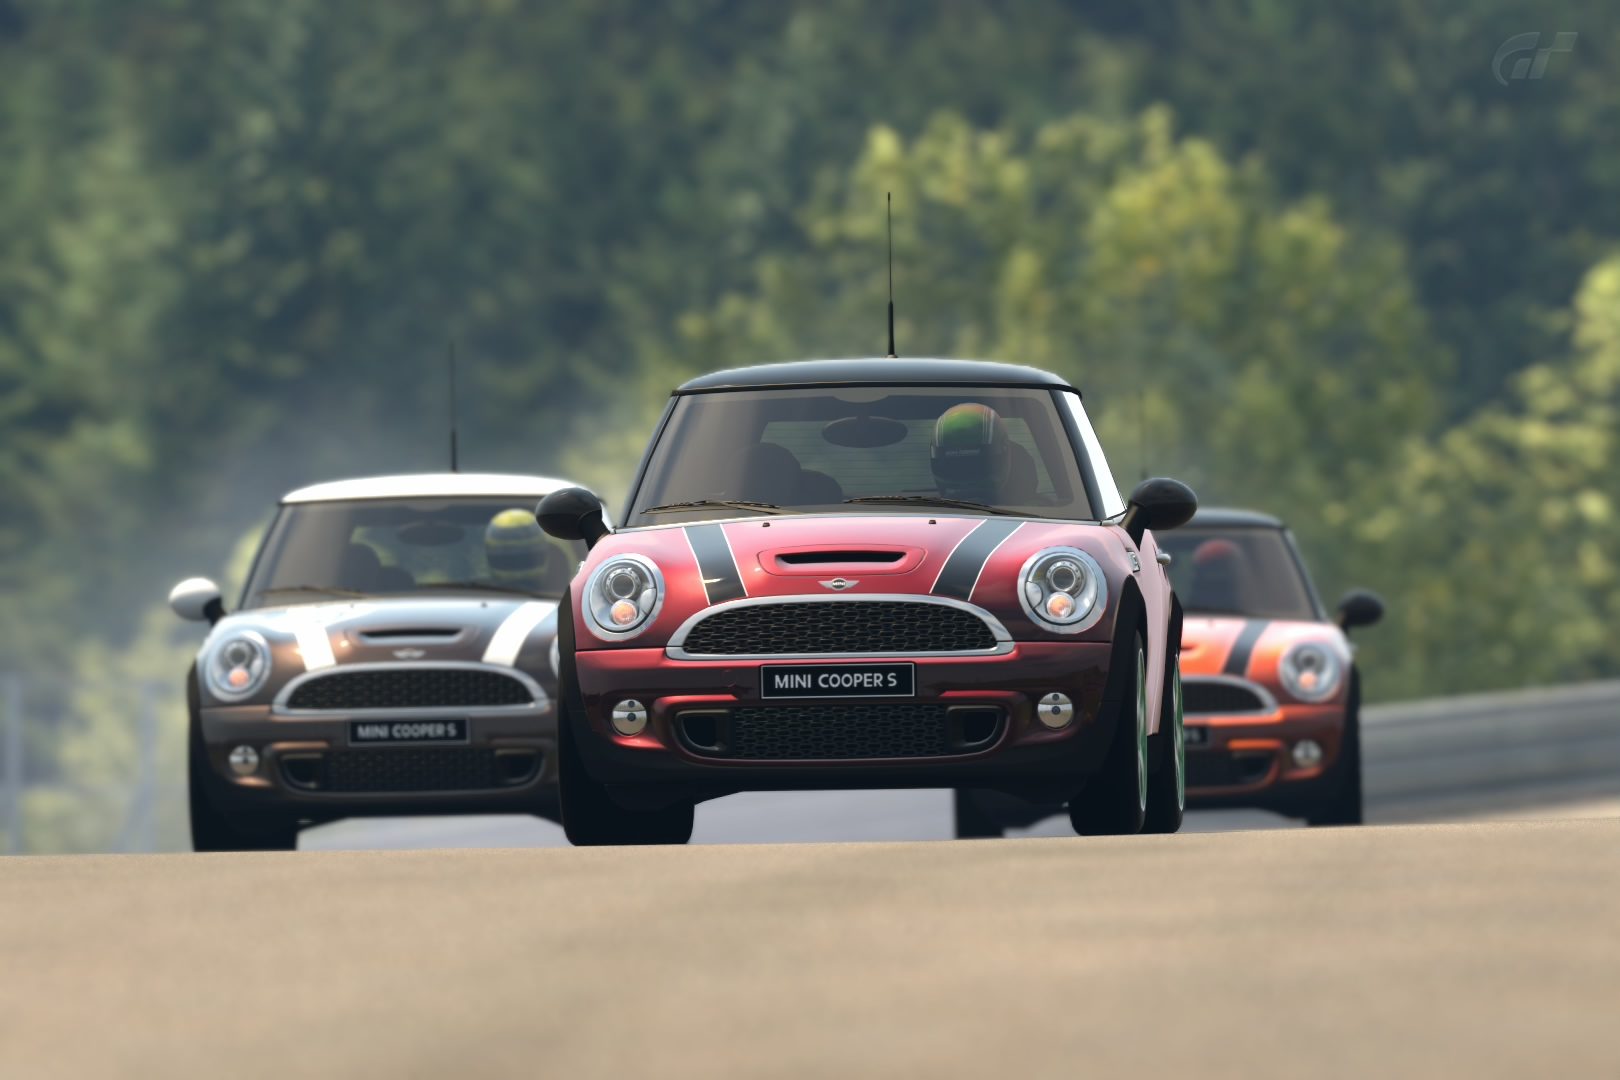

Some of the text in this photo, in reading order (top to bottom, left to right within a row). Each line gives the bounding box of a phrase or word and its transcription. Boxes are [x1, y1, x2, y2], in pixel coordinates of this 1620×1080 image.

[774, 672, 898, 689] MINI COOPER S
[357, 722, 457, 739] MINI COOPER S
